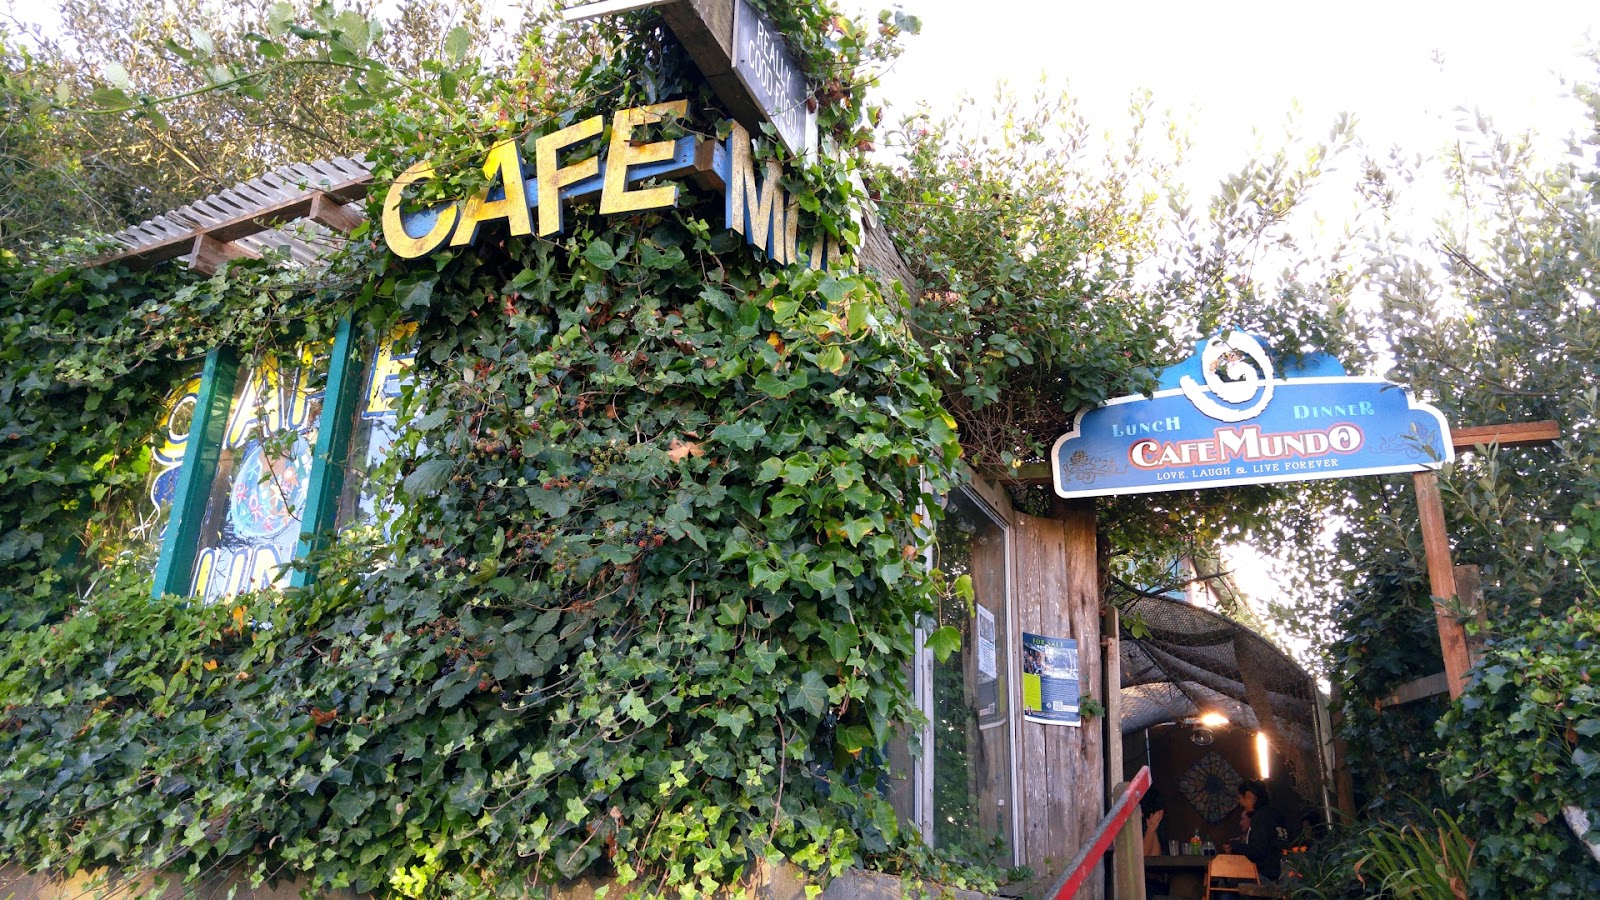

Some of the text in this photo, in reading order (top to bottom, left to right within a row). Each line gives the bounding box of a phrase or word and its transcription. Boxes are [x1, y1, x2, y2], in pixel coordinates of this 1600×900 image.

[757, 19, 792, 93] REALLY
[774, 80, 797, 134] FOOD
[382, 99, 690, 260] CAFE
[1112, 400, 1375, 438] LUNCH DINNER
[1192, 466, 1231, 478] LAUGH
[1235, 466, 1248, 475] &
[1253, 463, 1280, 474] LIVE
[1284, 458, 1339, 471] FOREVER
[1032, 637, 1045, 646] FOR
